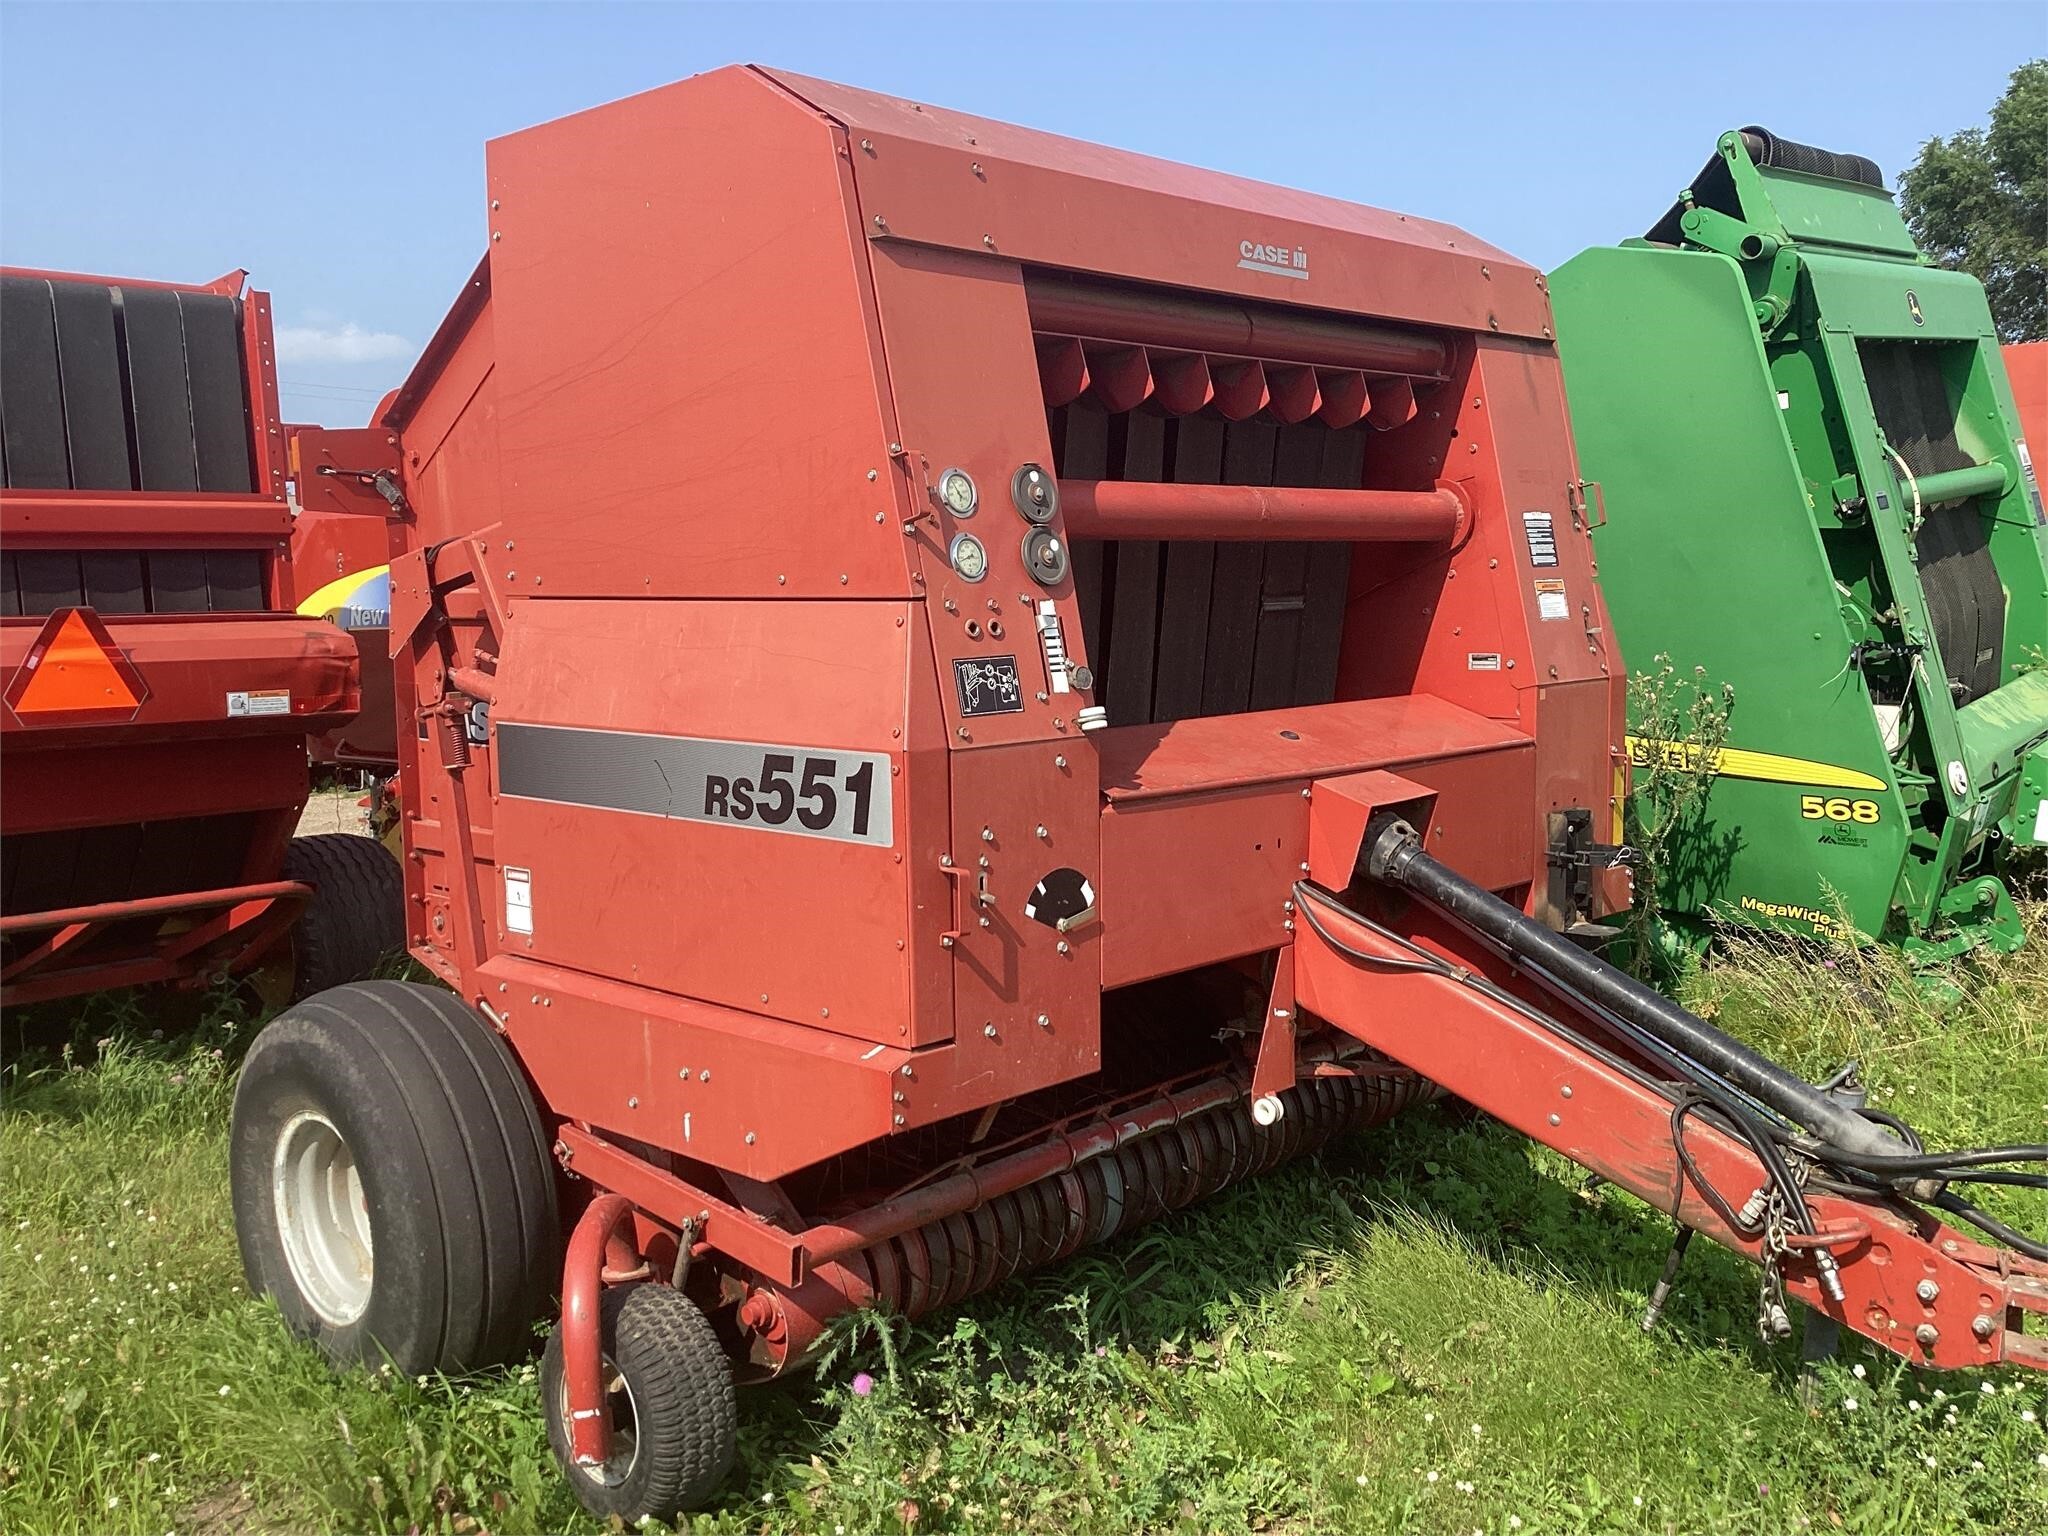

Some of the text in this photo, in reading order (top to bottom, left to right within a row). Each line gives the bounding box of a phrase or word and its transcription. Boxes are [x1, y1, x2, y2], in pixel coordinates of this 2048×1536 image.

[1240, 240, 1288, 265] CASE
[350, 604, 385, 627] New
[704, 753, 874, 836] RS551
[1801, 794, 1880, 825] 568
[1741, 895, 1832, 925] MegaWide
[1812, 923, 1847, 940] Plus
